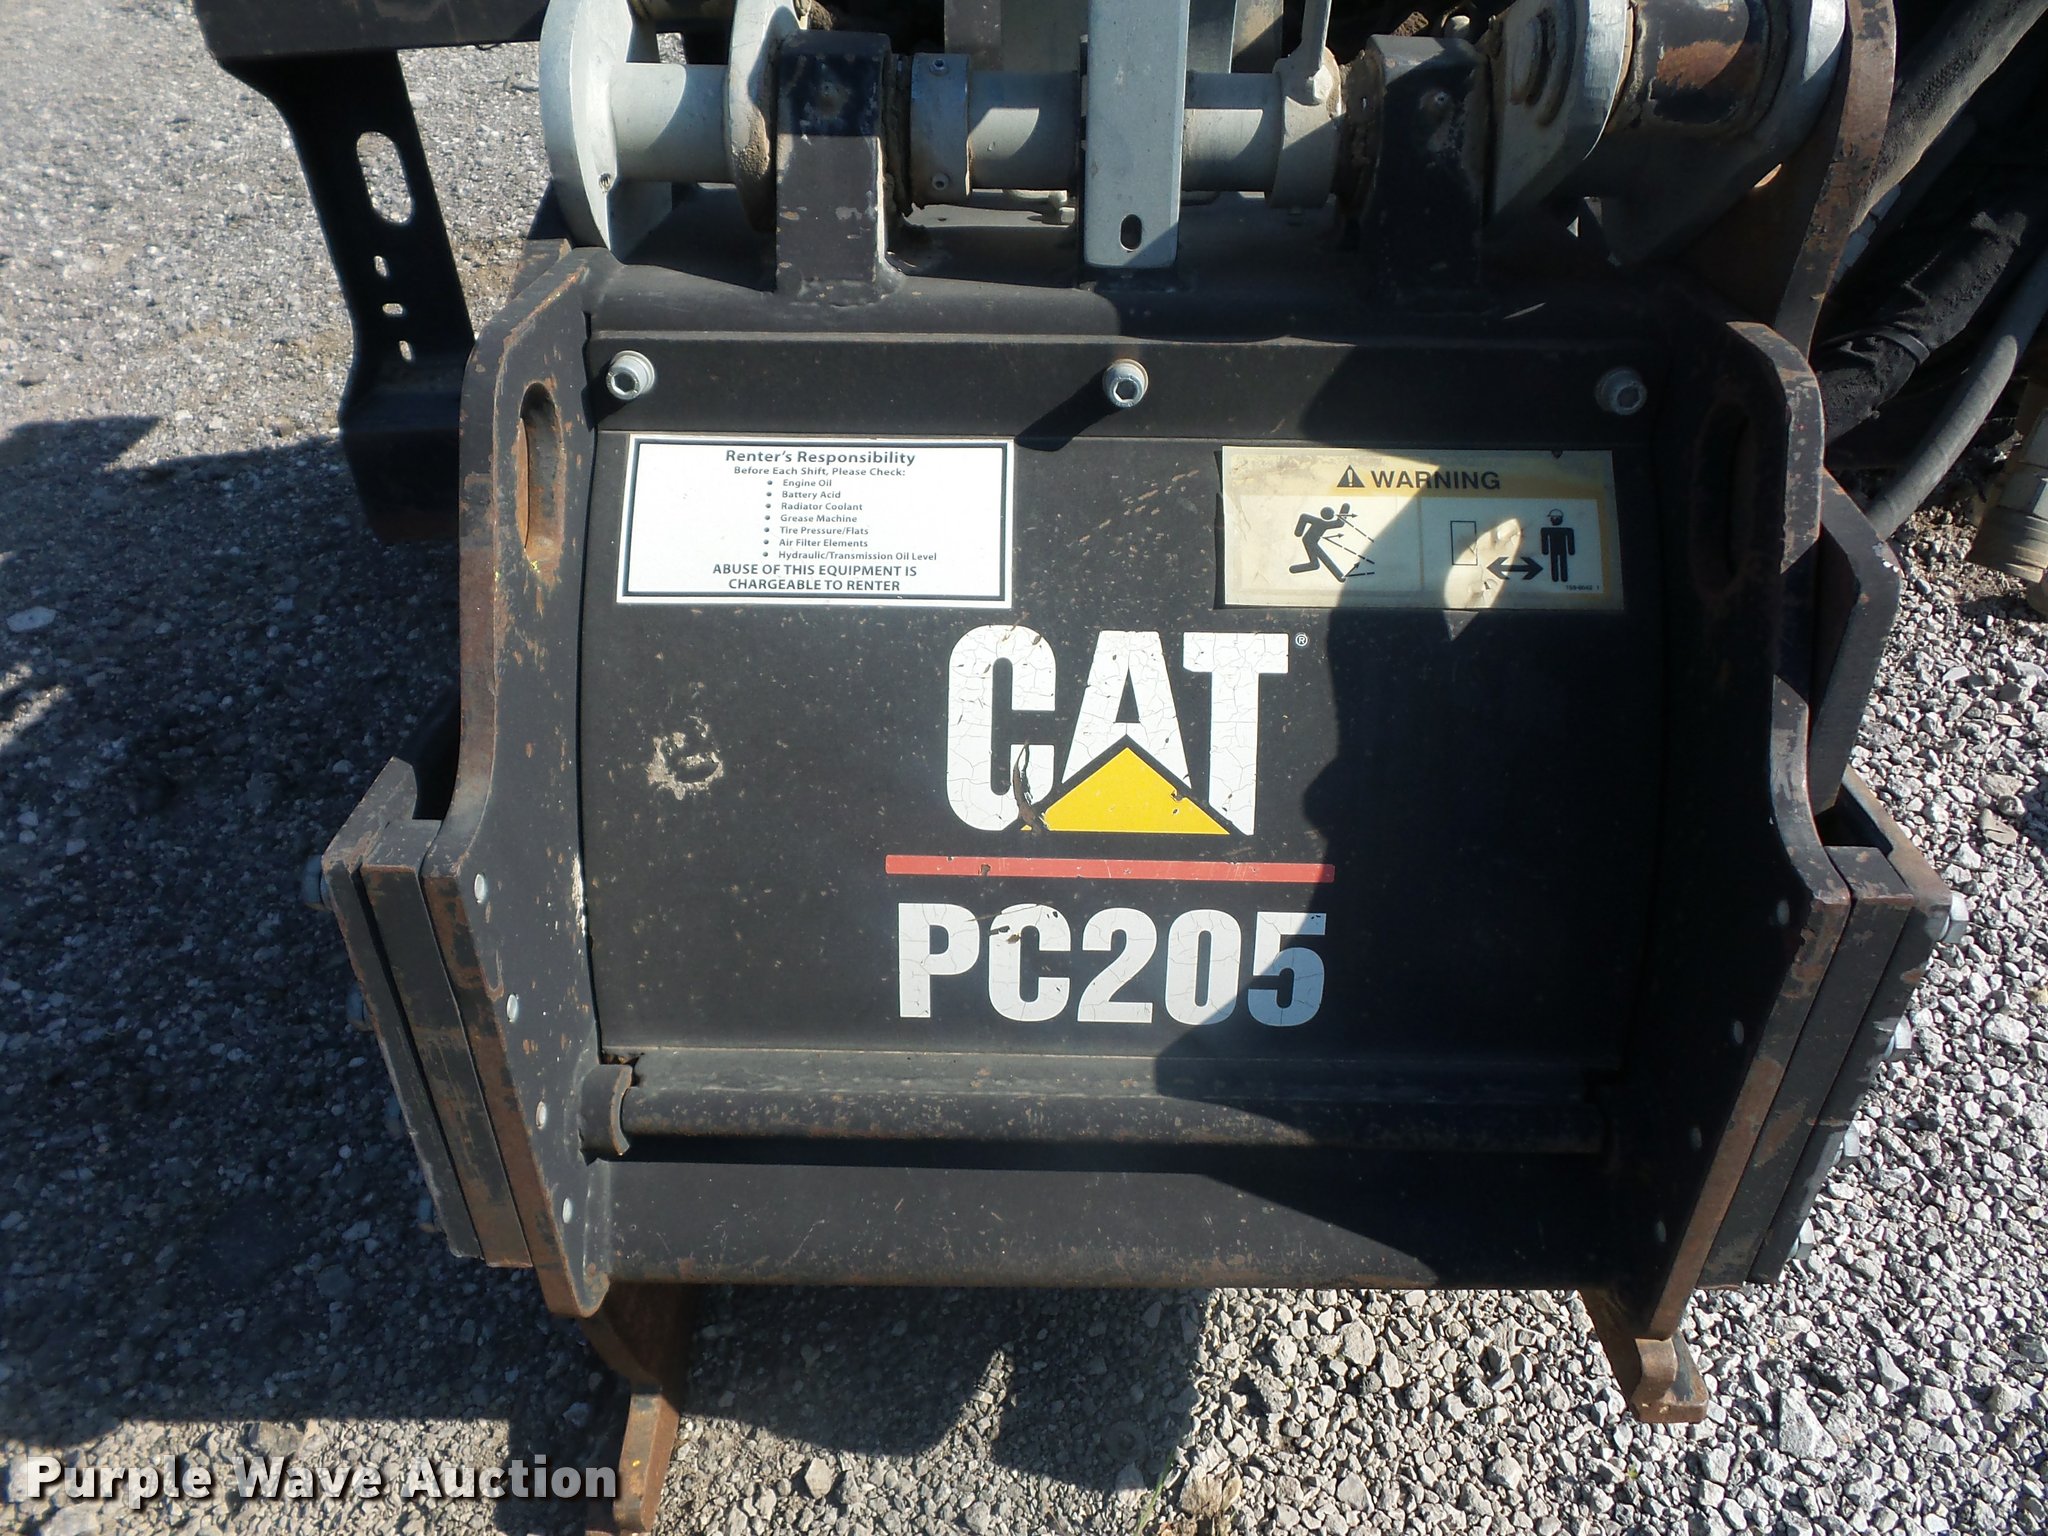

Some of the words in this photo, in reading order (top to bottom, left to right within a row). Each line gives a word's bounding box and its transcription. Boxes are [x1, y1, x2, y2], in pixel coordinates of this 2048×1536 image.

[726, 450, 792, 462] Renter's
[797, 451, 915, 466] Responsibility
[734, 466, 769, 474] Before
[773, 467, 797, 475] Each
[801, 467, 828, 476] Shift,
[870, 468, 905, 476] Check:
[783, 479, 816, 488] Engine
[1371, 470, 1501, 490] WARNING
[782, 491, 817, 500] Battery
[782, 502, 822, 510] Radiator
[781, 514, 813, 522] Grease
[780, 526, 798, 534] Tire
[824, 539, 868, 547] Elements
[779, 551, 893, 560] Hydraulic/Transmission
[896, 552, 909, 560] Oil
[713, 564, 758, 574] ABUSE
[762, 564, 780, 574] OF
[784, 565, 814, 575] THIS
[819, 565, 901, 576] EQUIPMENT
[906, 566, 917, 576] IS
[729, 579, 821, 590] CHARGEABLE
[824, 580, 842, 590] TO
[847, 580, 900, 591] RENTER
[946, 624, 1289, 836] CAT
[897, 902, 1327, 1027] PC205
